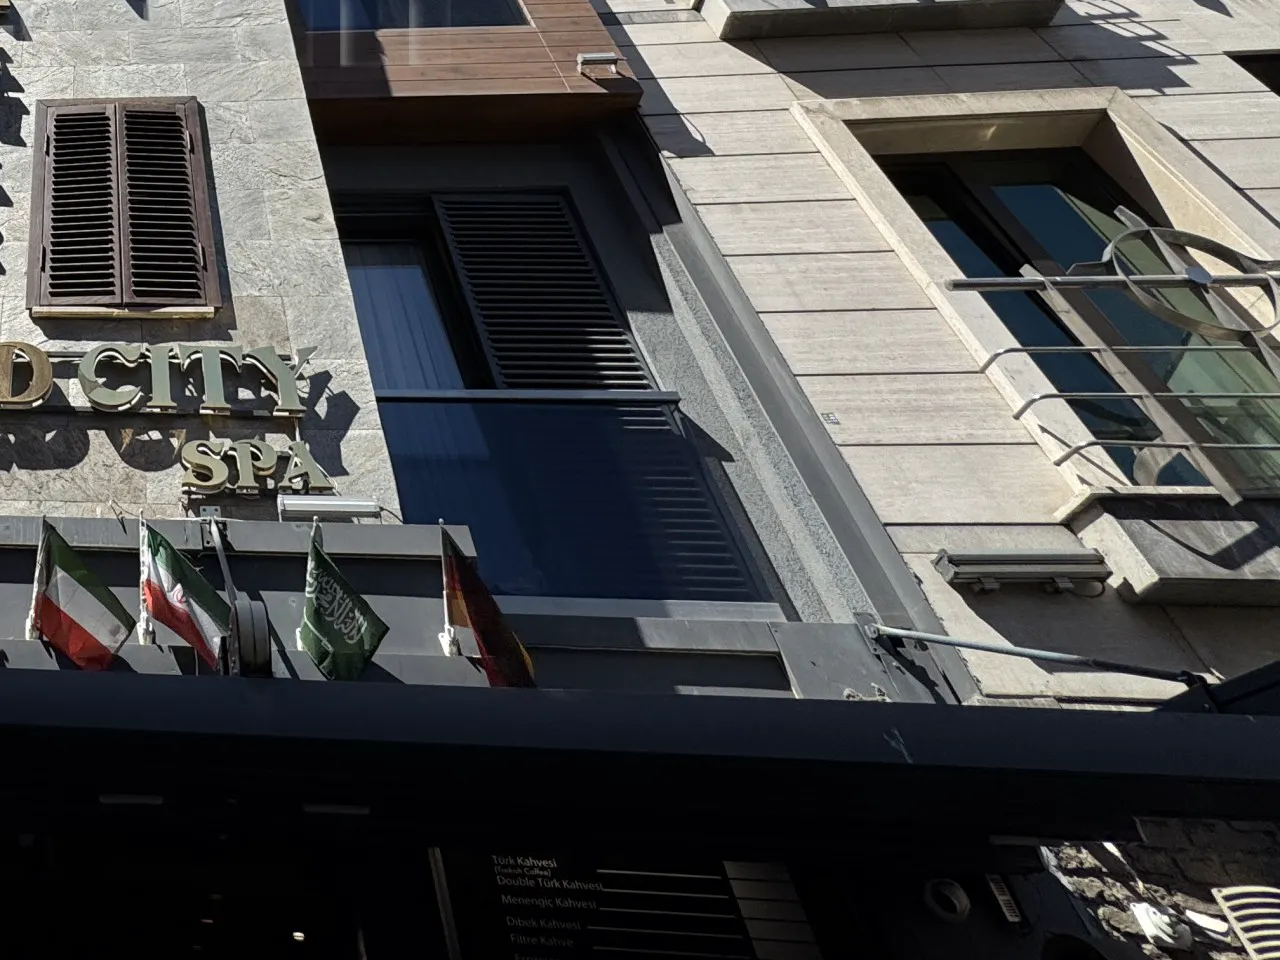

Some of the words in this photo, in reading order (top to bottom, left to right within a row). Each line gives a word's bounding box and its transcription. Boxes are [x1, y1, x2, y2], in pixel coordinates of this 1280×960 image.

[77, 342, 319, 417] CITY
[180, 440, 337, 495] SPA
[492, 855, 515, 866] Türk
[517, 856, 558, 869] Kahvesi
[496, 875, 536, 888] Double
[536, 877, 562, 889] Türk
[562, 879, 604, 891] Kahvesi
[555, 897, 597, 909] Kahvesi
[505, 915, 539, 928] Dibek
[539, 918, 581, 930] Kahvesi
[510, 933, 539, 946] Filtre
[539, 935, 576, 948] Kahve
